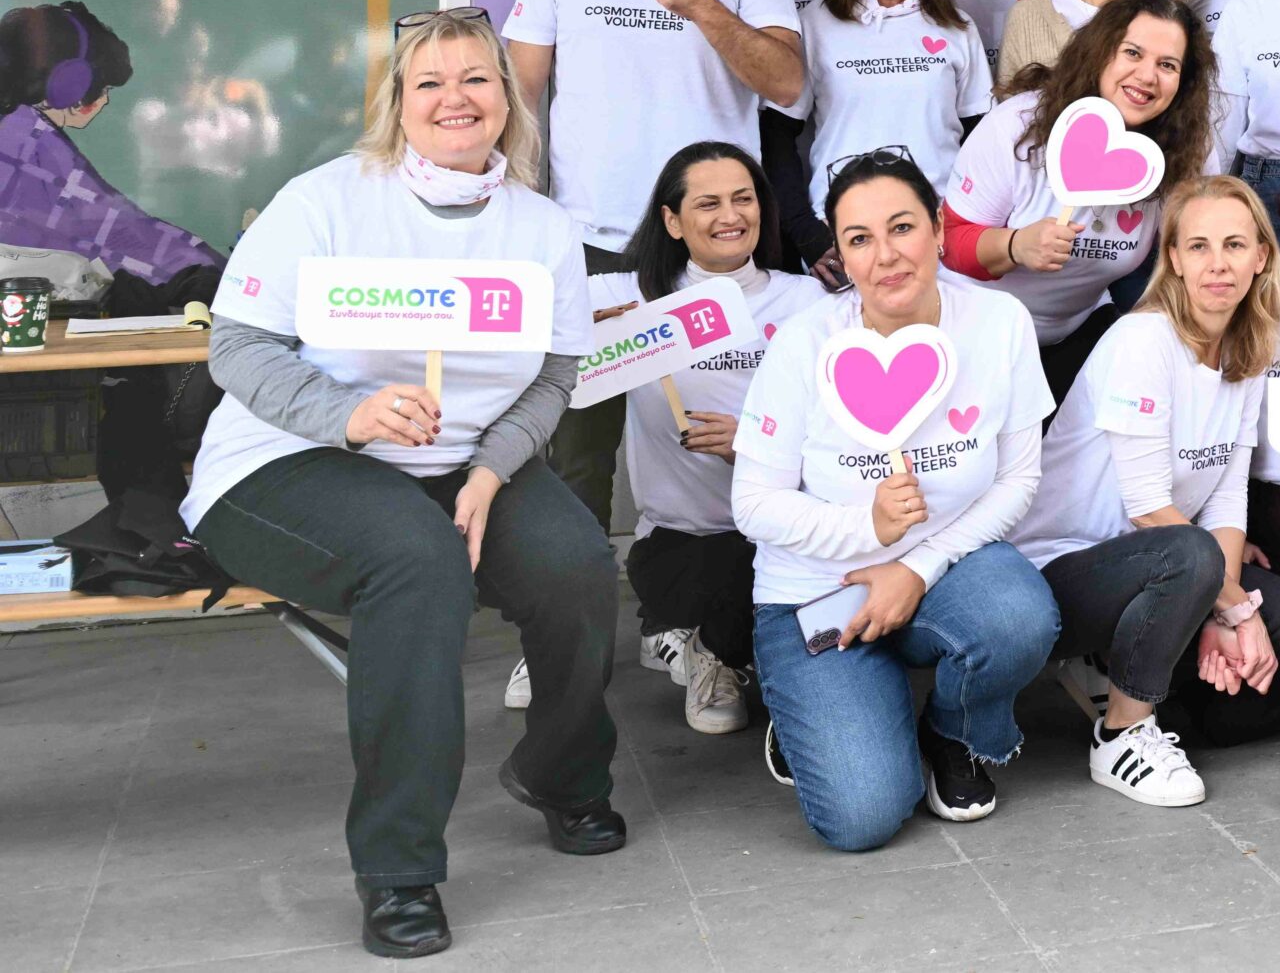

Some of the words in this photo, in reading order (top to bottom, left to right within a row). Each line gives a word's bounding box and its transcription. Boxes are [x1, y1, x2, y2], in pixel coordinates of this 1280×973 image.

[585, 6, 646, 18] COSMOTE
[605, 16, 684, 31] VOLUNTEERS
[836, 58, 893, 69] COSMOTE
[895, 56, 946, 65] TELEKOM
[856, 64, 930, 75] VOLUNTEERS
[1083, 238, 1138, 250] TELEKOM
[1070, 248, 1118, 260] NTEERS
[328, 287, 456, 307] COSMOTE
[329, 309, 382, 319] Συνδέουμε
[402, 311, 432, 321] κόσμο
[577, 323, 673, 372] COSMOTE
[622, 356, 636, 366] τον
[637, 347, 660, 360] κόσμο
[734, 350, 765, 360] TELE
[690, 359, 760, 370] OLUNTEE
[912, 438, 978, 460] TELEKOM
[860, 456, 957, 480] VOLTEERS
